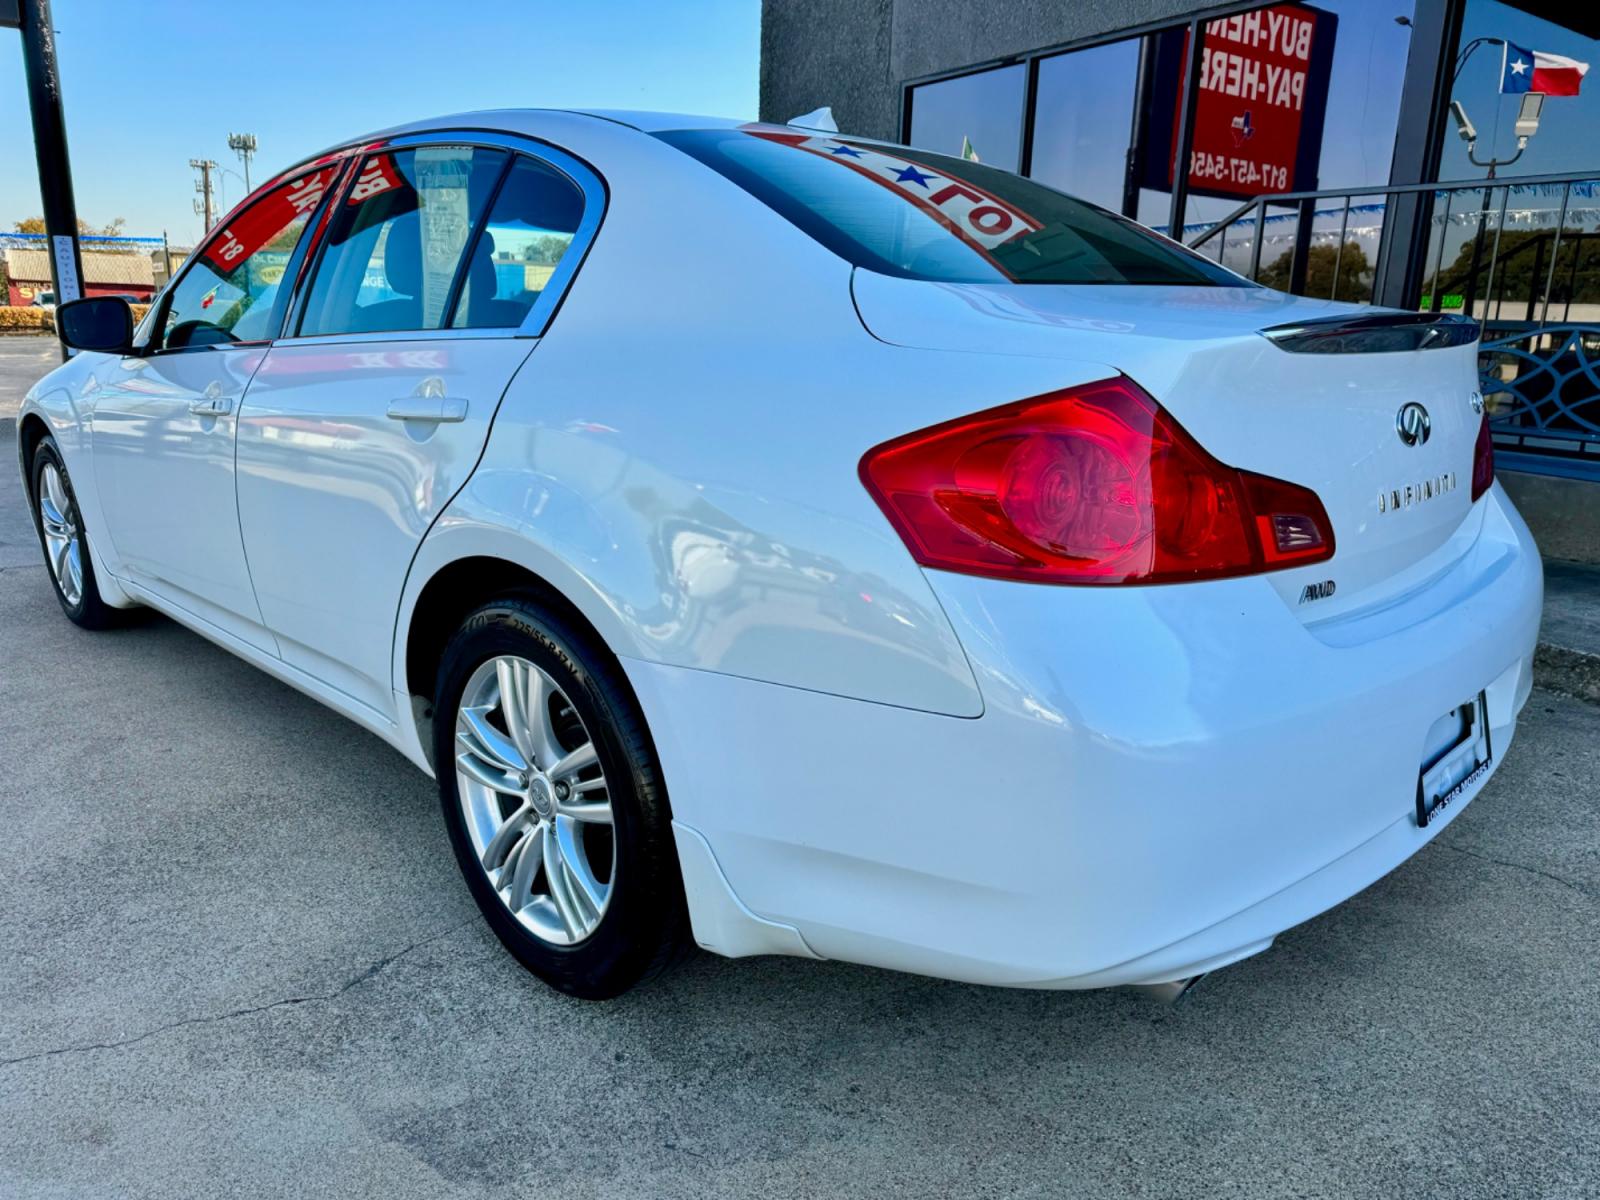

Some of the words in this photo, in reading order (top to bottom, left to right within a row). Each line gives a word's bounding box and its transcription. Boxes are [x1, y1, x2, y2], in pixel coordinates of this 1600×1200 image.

[1378, 472, 1457, 513] INFINITI
[1299, 579, 1336, 604] AWD
[1443, 786, 1461, 807] STAR
